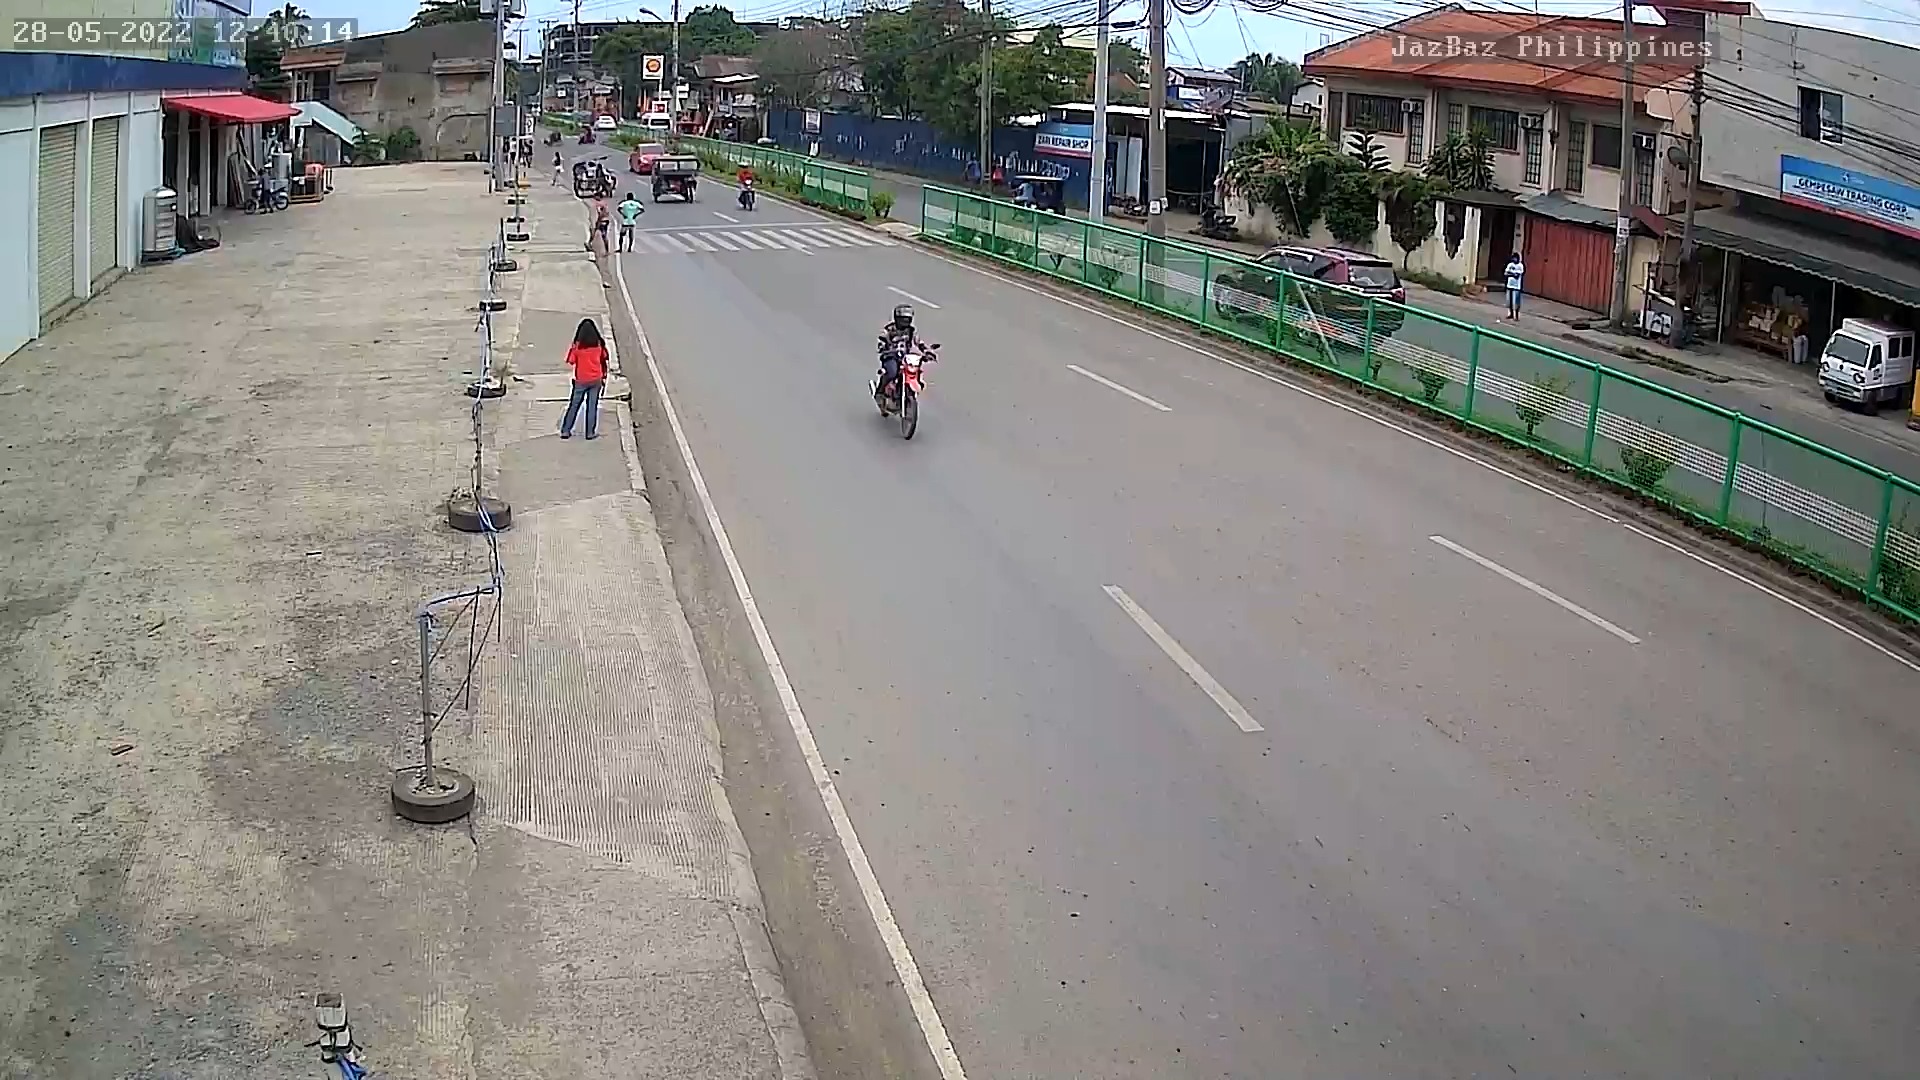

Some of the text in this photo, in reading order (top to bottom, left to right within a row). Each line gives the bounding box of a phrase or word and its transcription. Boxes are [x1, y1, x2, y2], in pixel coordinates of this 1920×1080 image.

[1052, 136, 1071, 148] REPAIR
[1072, 139, 1089, 149] SHOP
[1846, 189, 1883, 208] TRADING
